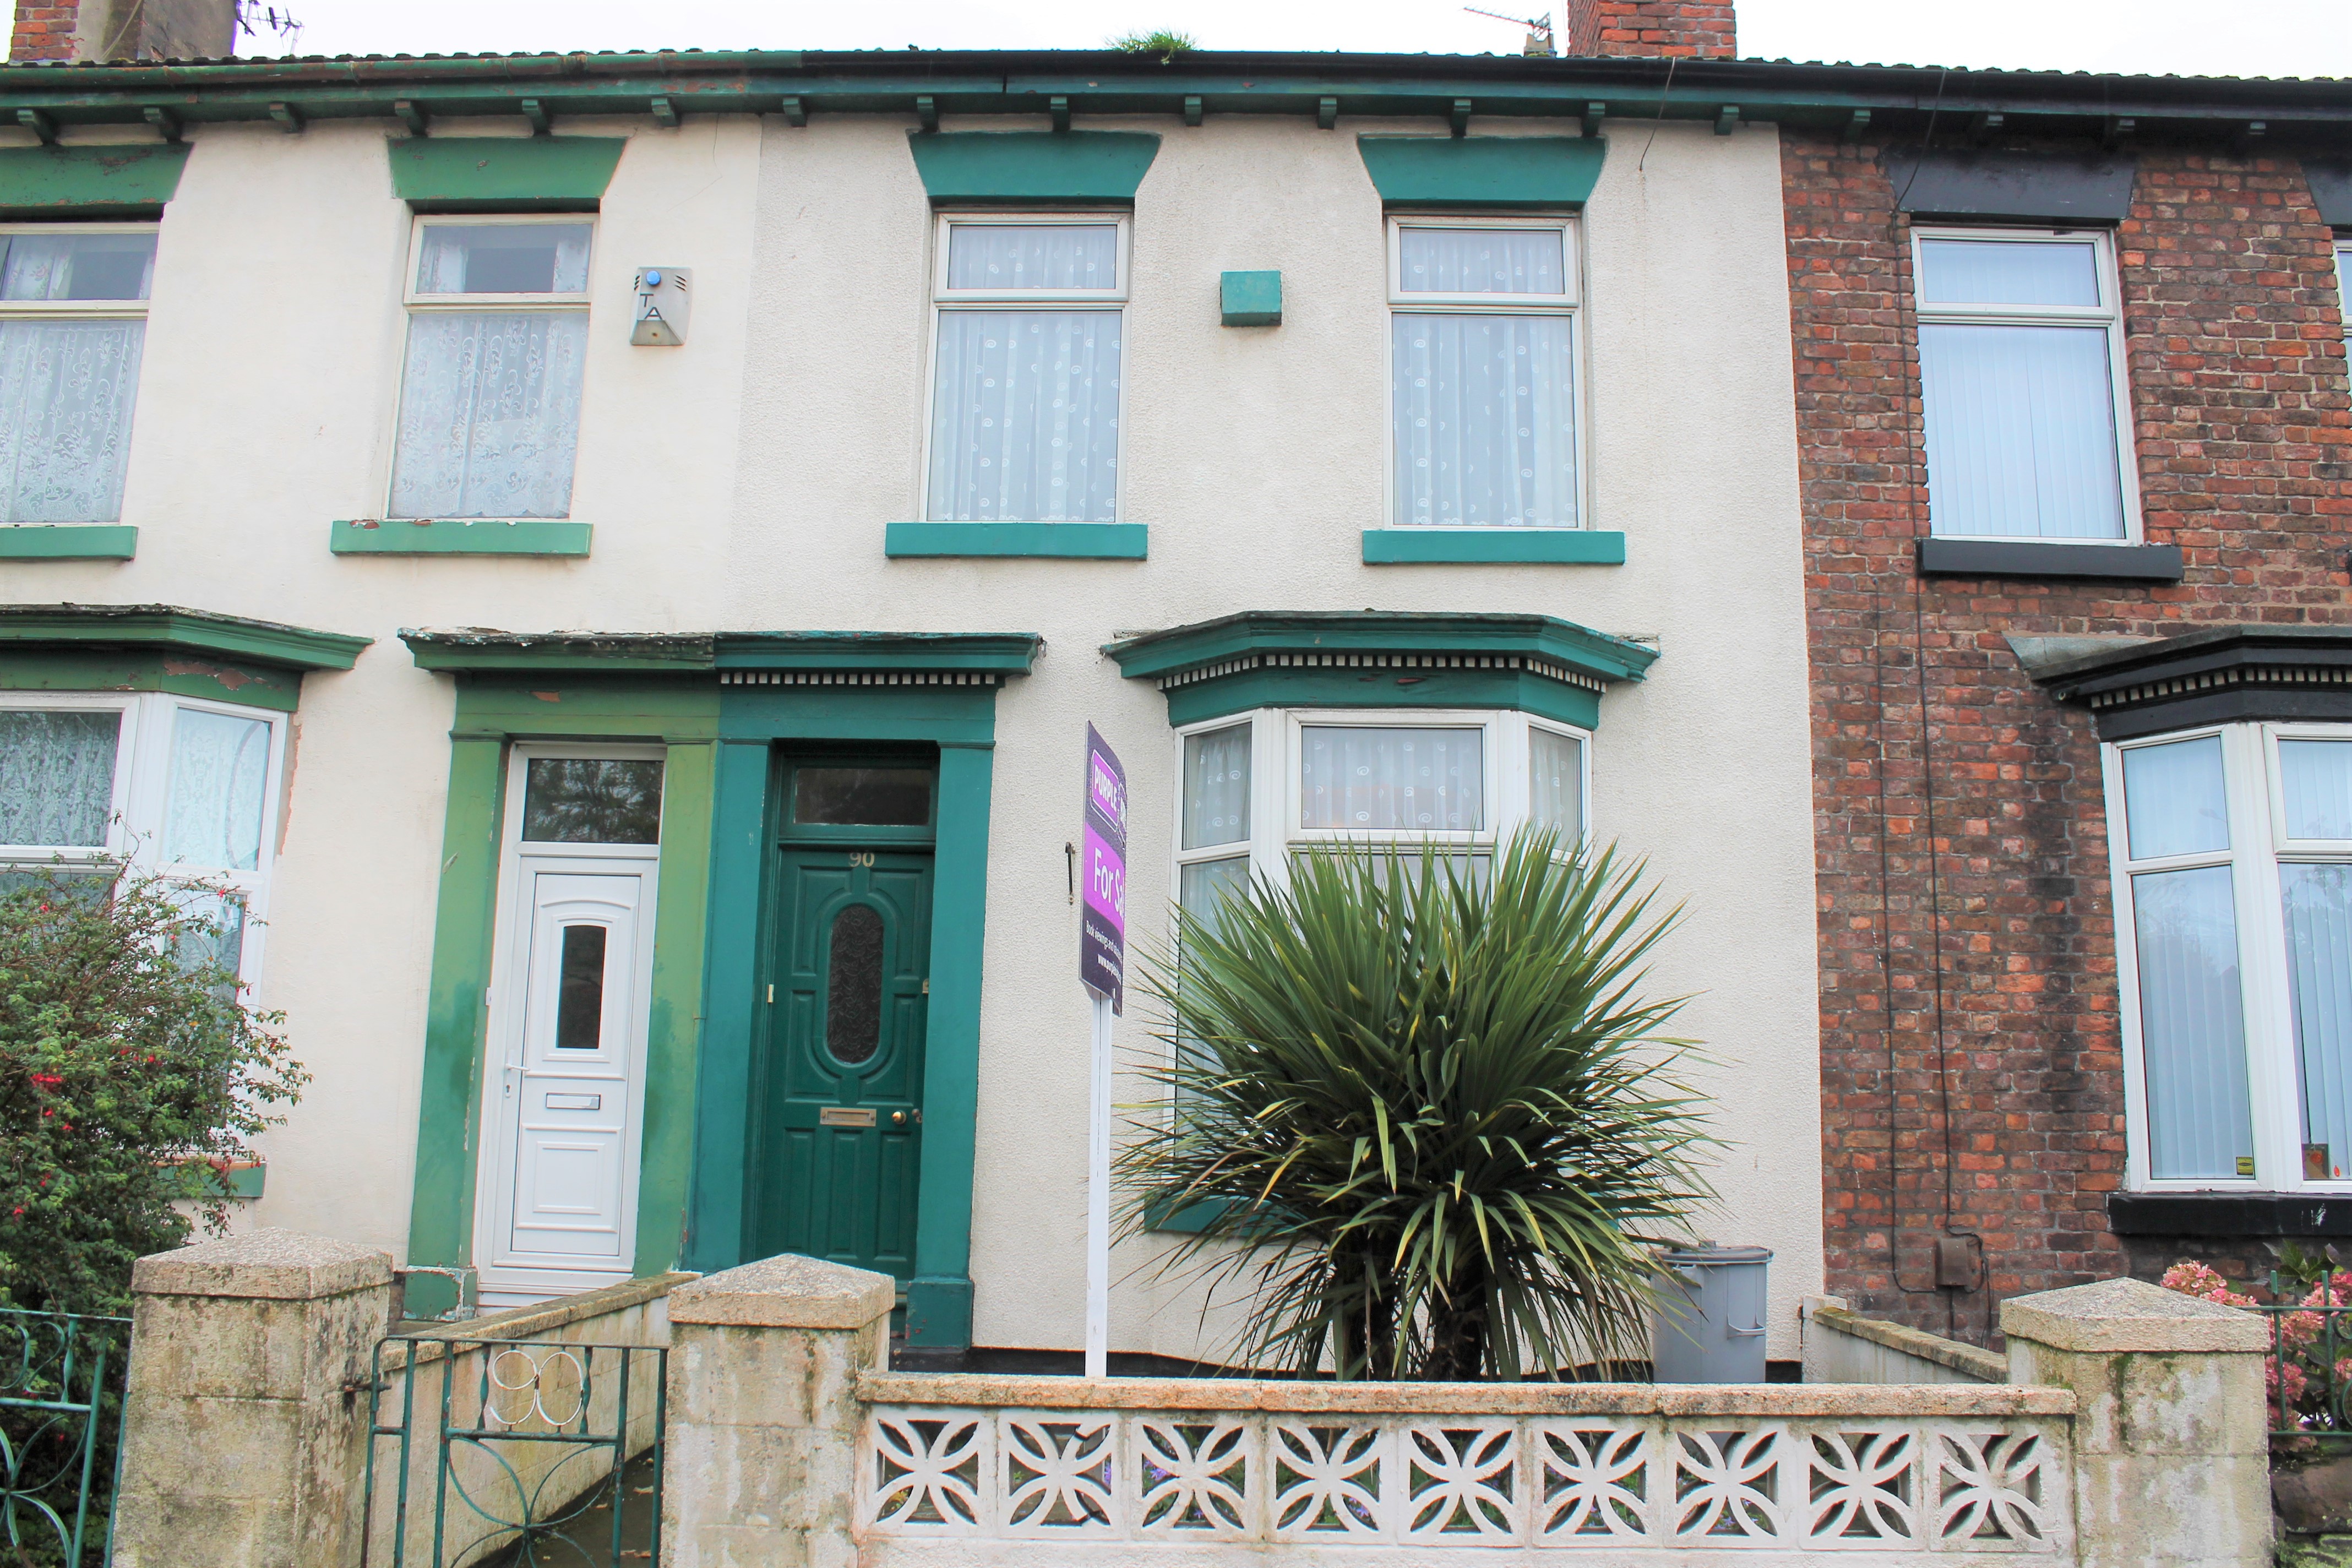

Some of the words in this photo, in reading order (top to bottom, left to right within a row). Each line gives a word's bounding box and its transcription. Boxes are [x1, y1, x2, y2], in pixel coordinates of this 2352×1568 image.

[1095, 764, 1117, 813] PURPLE
[848, 852, 875, 867] 90
[1094, 847, 1114, 903] For
[490, 1349, 584, 1427] 90
